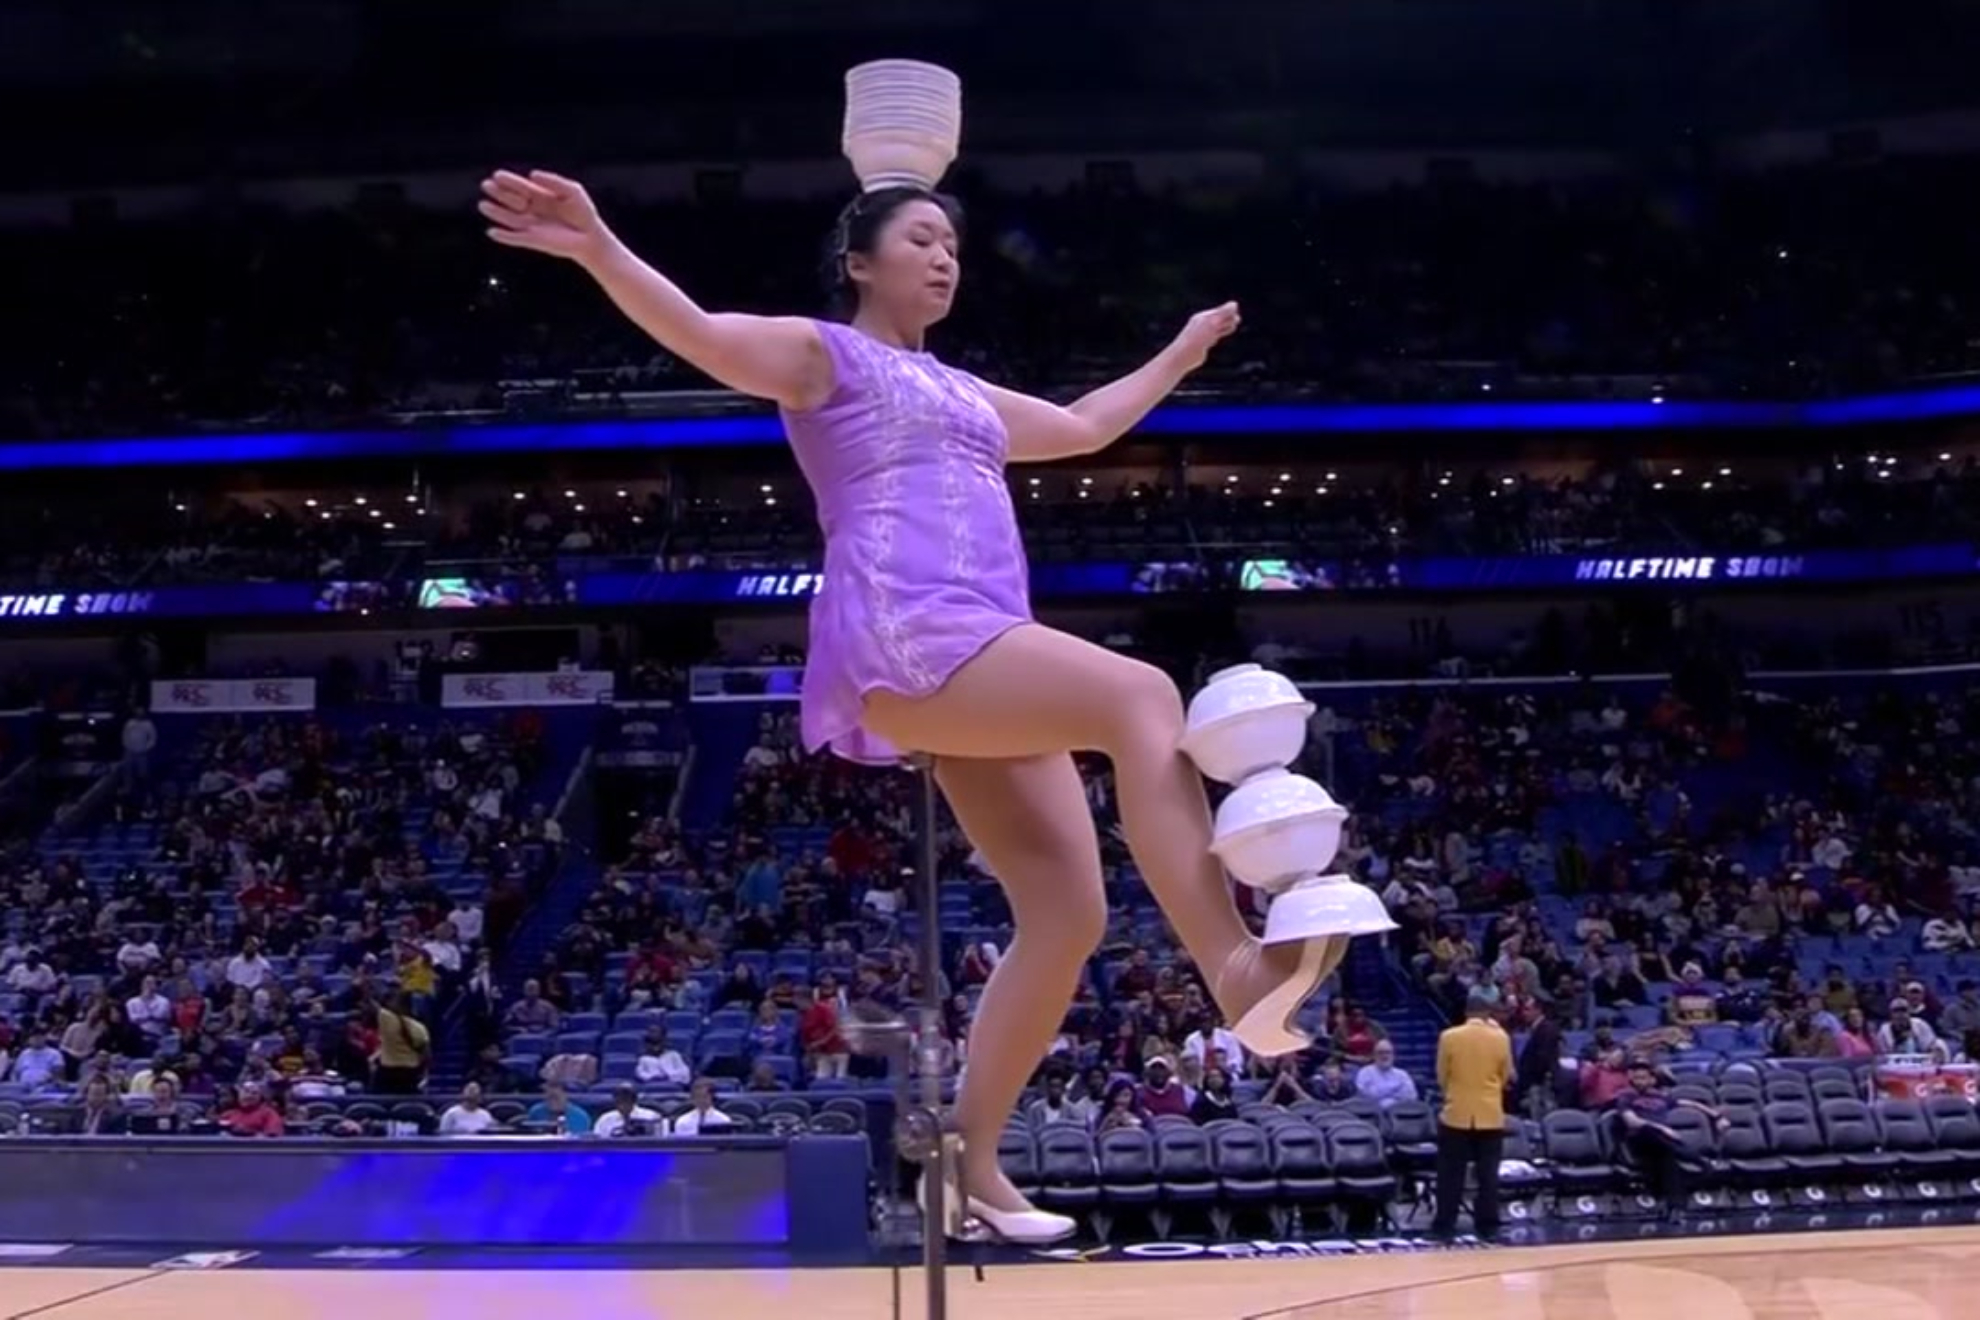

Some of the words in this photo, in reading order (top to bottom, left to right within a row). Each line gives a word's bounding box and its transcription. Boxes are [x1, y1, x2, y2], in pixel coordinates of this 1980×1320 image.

[1575, 557, 1715, 580] HALFTIME
[0, 594, 64, 616] TIME
[1508, 1201, 1526, 1219] G
[1577, 1196, 1595, 1214] G
